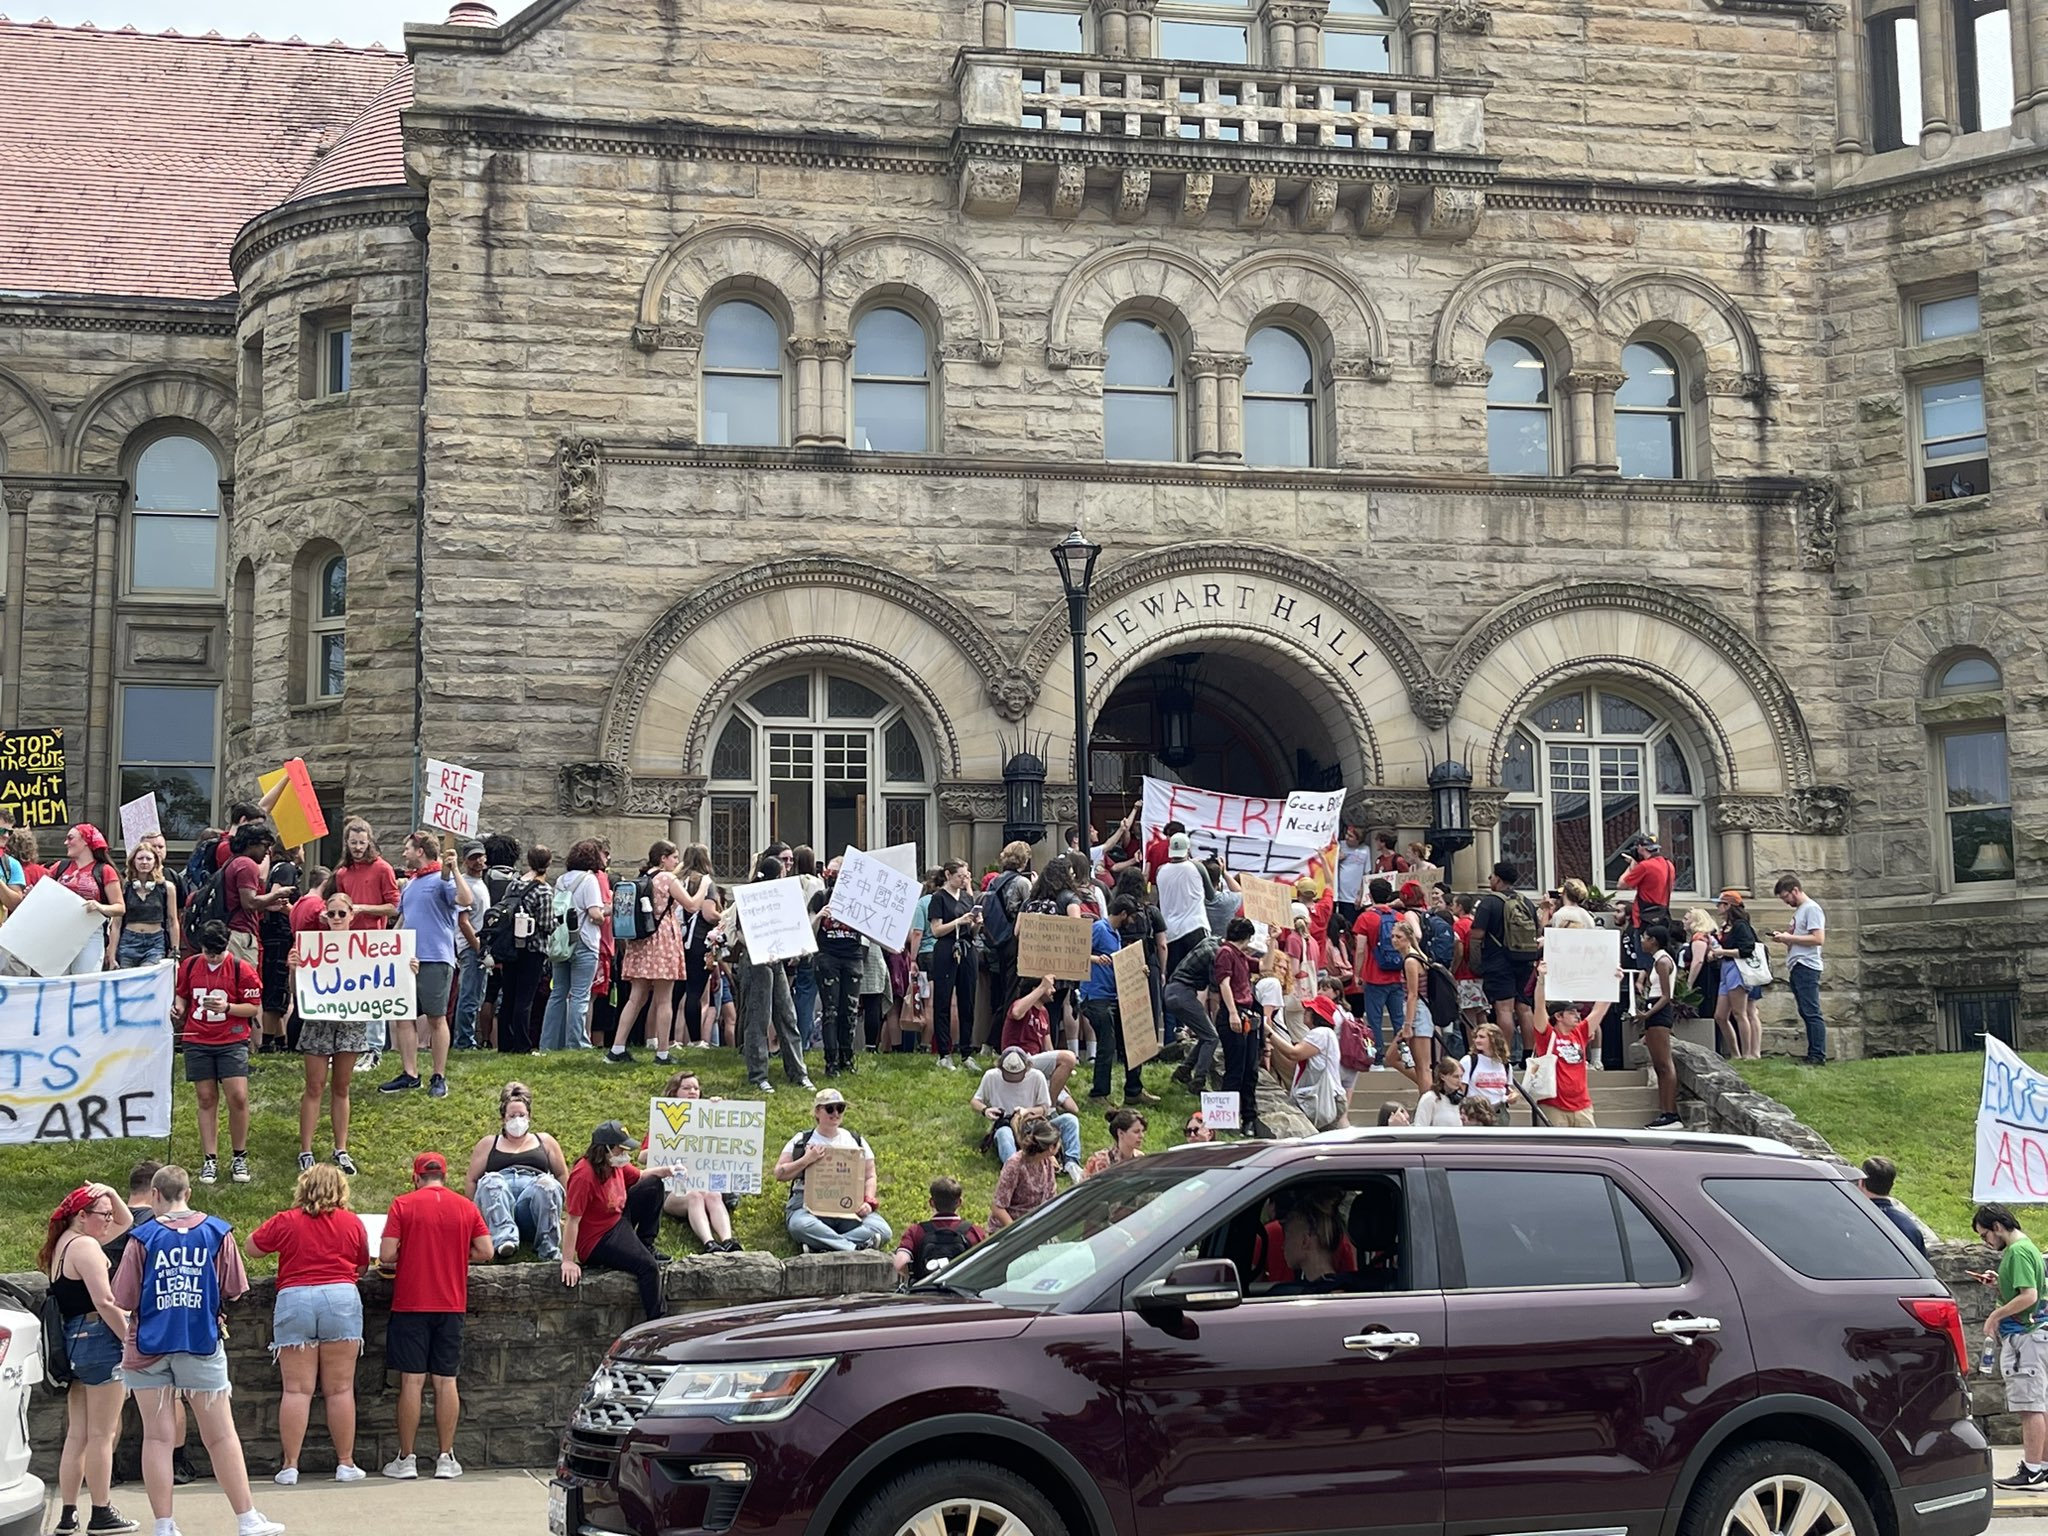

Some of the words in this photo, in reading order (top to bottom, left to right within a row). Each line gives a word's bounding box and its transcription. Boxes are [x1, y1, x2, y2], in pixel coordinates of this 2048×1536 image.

[1271, 593, 1369, 677] HALL
[3, 735, 55, 755] STOP
[0, 775, 62, 799] Audit
[441, 768, 473, 793] RIF
[0, 799, 68, 826] THEM
[444, 792, 465, 809] THE
[1168, 785, 1285, 836] FIR
[433, 803, 468, 833] RICH
[1285, 817, 1320, 833] Need
[1187, 829, 1300, 874] GEE
[296, 932, 339, 969] We
[348, 932, 401, 959] Need
[313, 963, 395, 995] World
[18, 974, 161, 1037] THE
[301, 990, 409, 1019] Languages
[1203, 1094, 1230, 1104] PROTECT
[698, 1108, 764, 1129] NEEDS
[1209, 1110, 1236, 1122] ARTS!
[655, 1133, 758, 1157] WRITERS
[695, 1158, 755, 1173] CREATIVE
[154, 1246, 208, 1270] ACLU
[155, 1274, 203, 1295] LEGAL
[156, 1291, 202, 1310] OBERER
